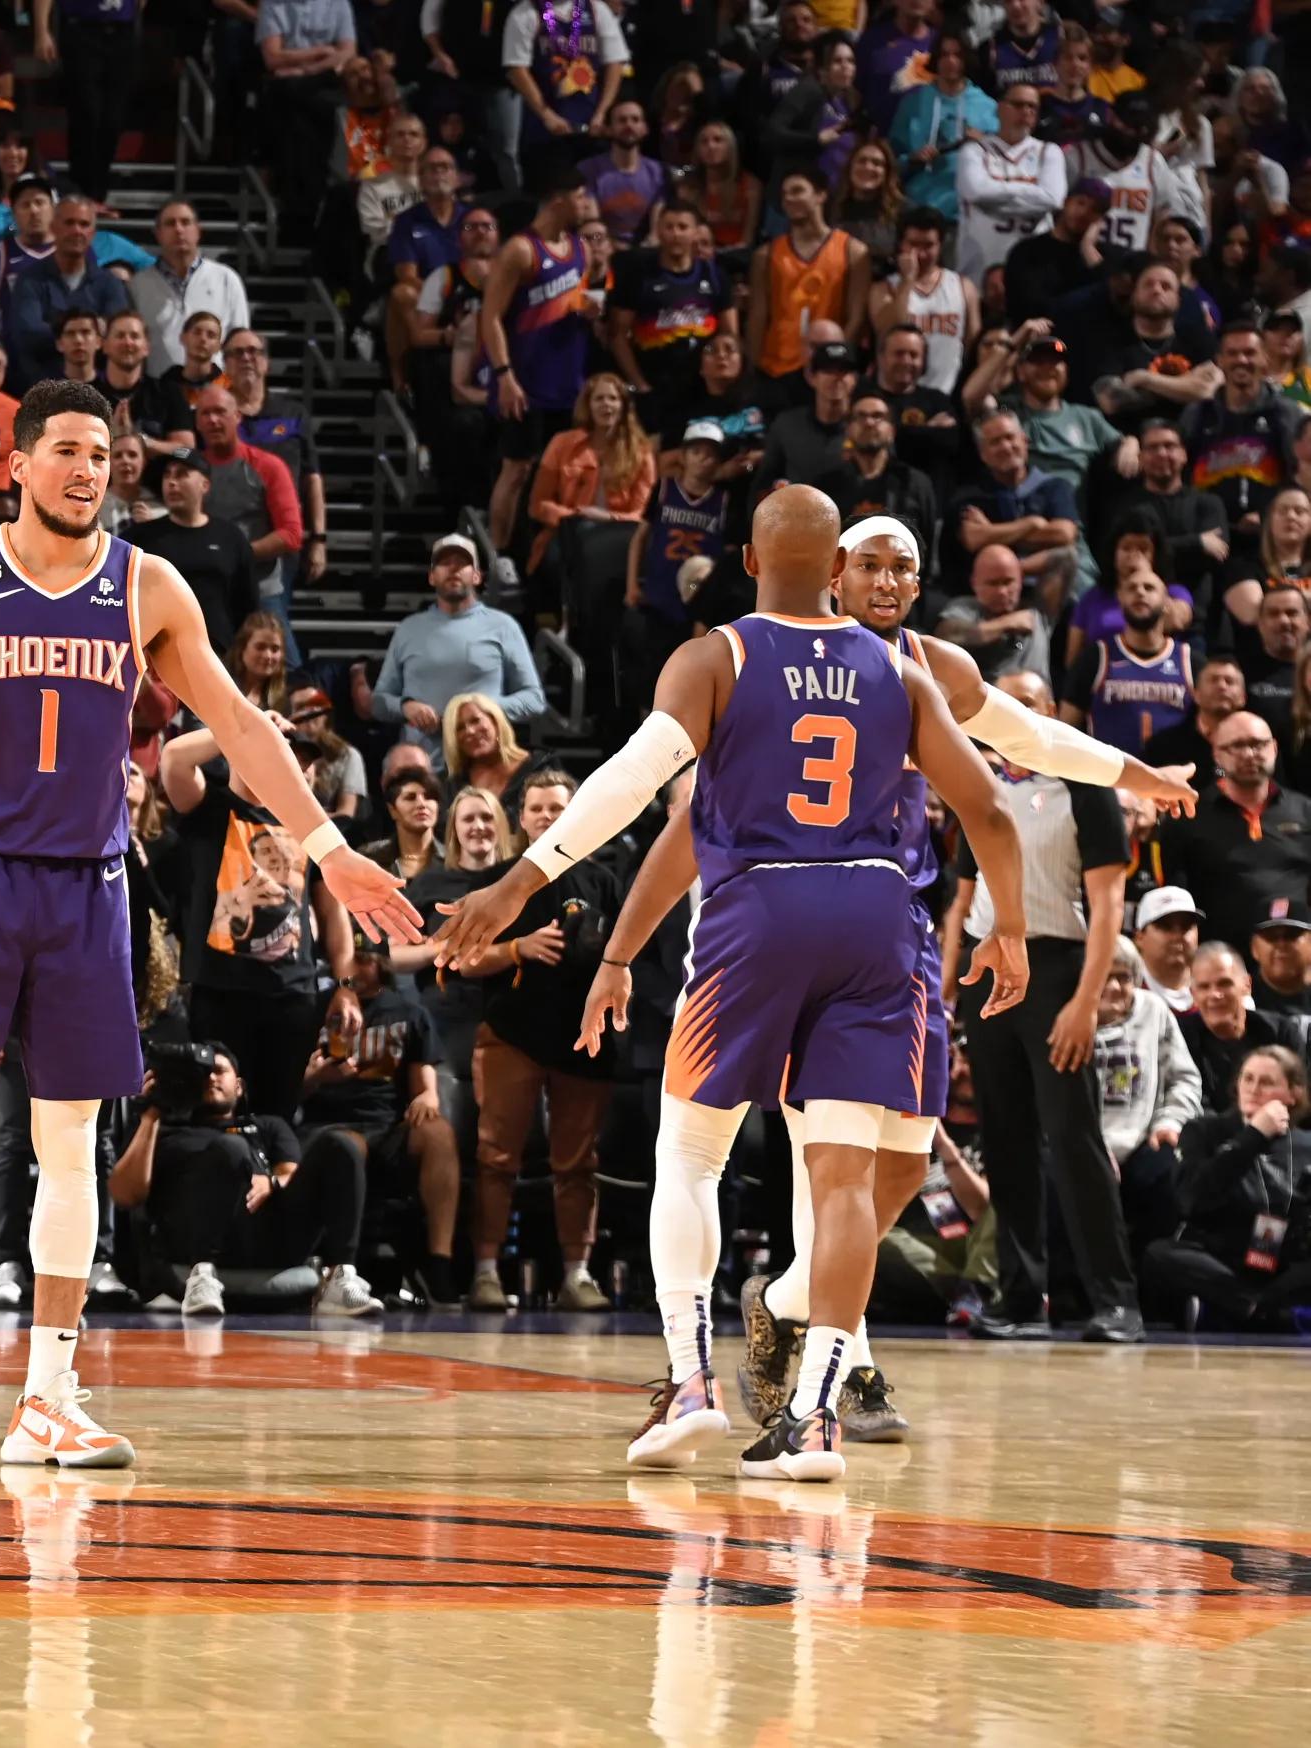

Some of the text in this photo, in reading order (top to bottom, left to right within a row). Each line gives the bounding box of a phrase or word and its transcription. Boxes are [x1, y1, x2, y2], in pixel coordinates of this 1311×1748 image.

[90, 595, 124, 608] PayPal
[783, 666, 861, 705] PAUL
[38, 688, 59, 772] 1
[786, 714, 857, 828] 3
